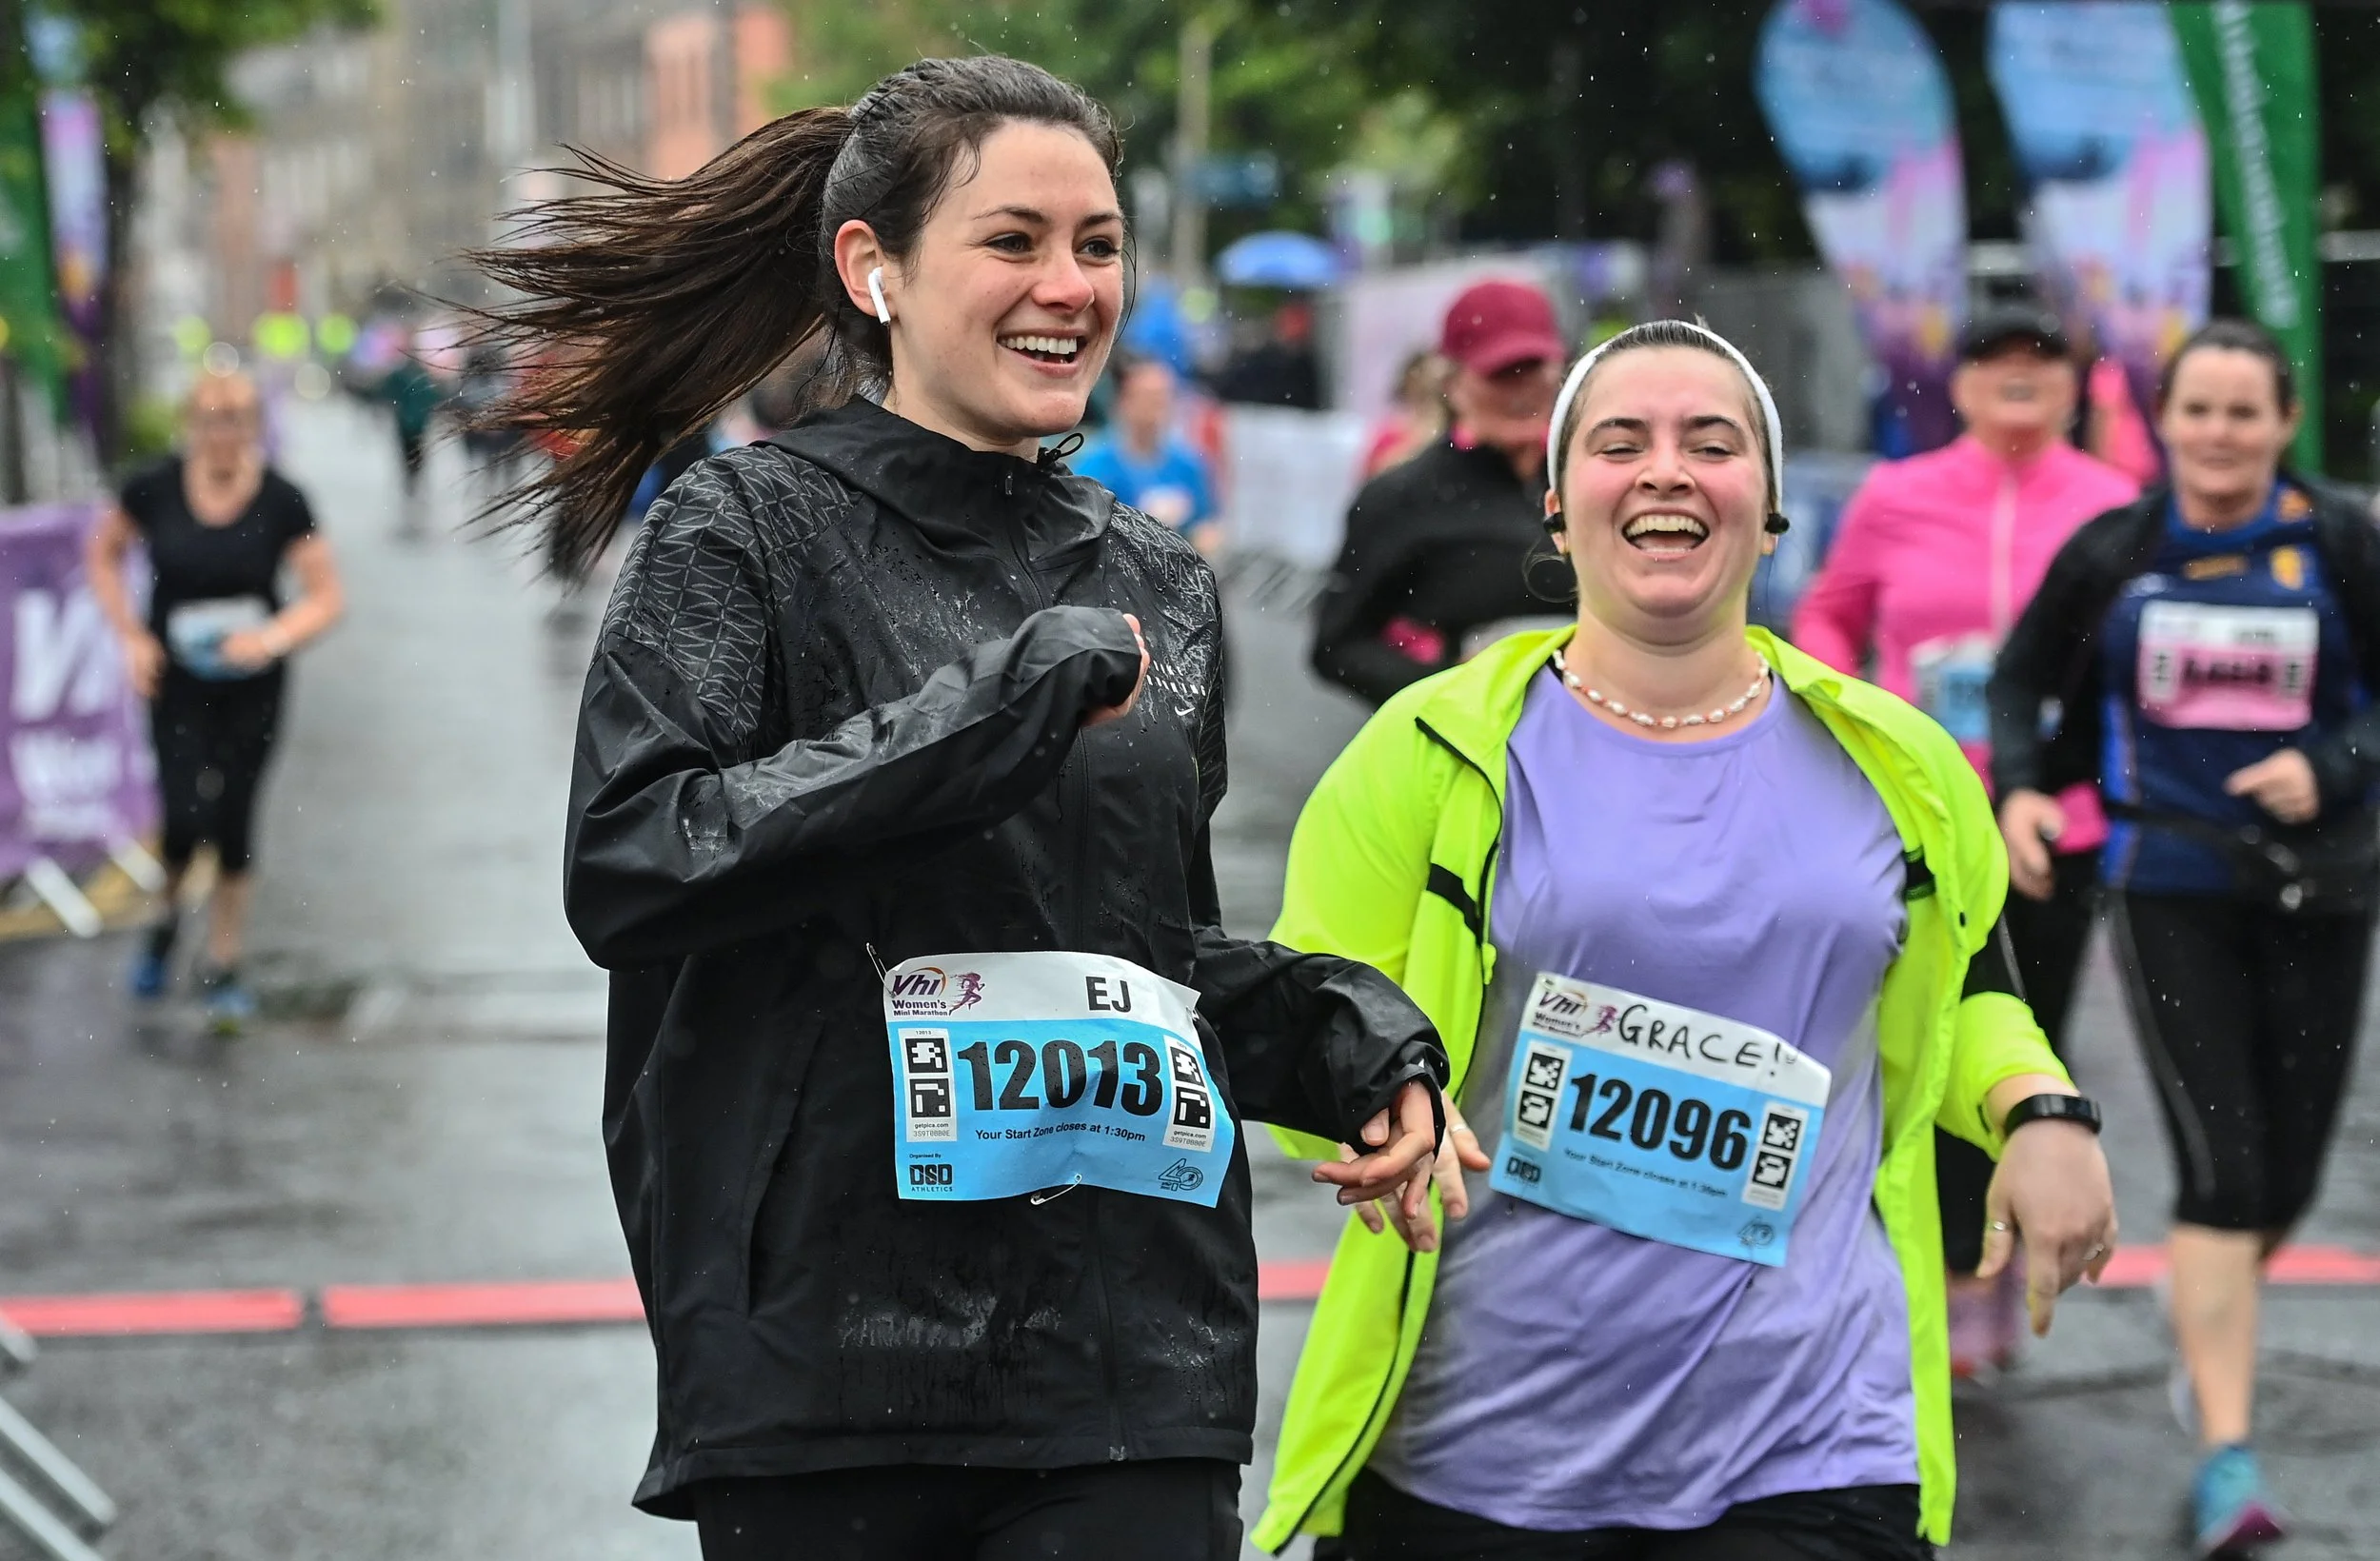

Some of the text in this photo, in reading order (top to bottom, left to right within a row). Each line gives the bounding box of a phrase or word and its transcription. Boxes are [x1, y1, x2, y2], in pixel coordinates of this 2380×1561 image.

[893, 974, 941, 996] Vhi
[1085, 976, 1131, 1013] EJ
[892, 999, 946, 1009] Women's
[1539, 991, 1582, 1015] Vhi
[1619, 1004, 1780, 1077] GRACE!
[957, 1039, 1163, 1116] 12013
[976, 1122, 1145, 1141] Your Start Zone closes at 1:30pm
[1569, 1074, 1752, 1171] 12096
[909, 1164, 952, 1185] DSD
